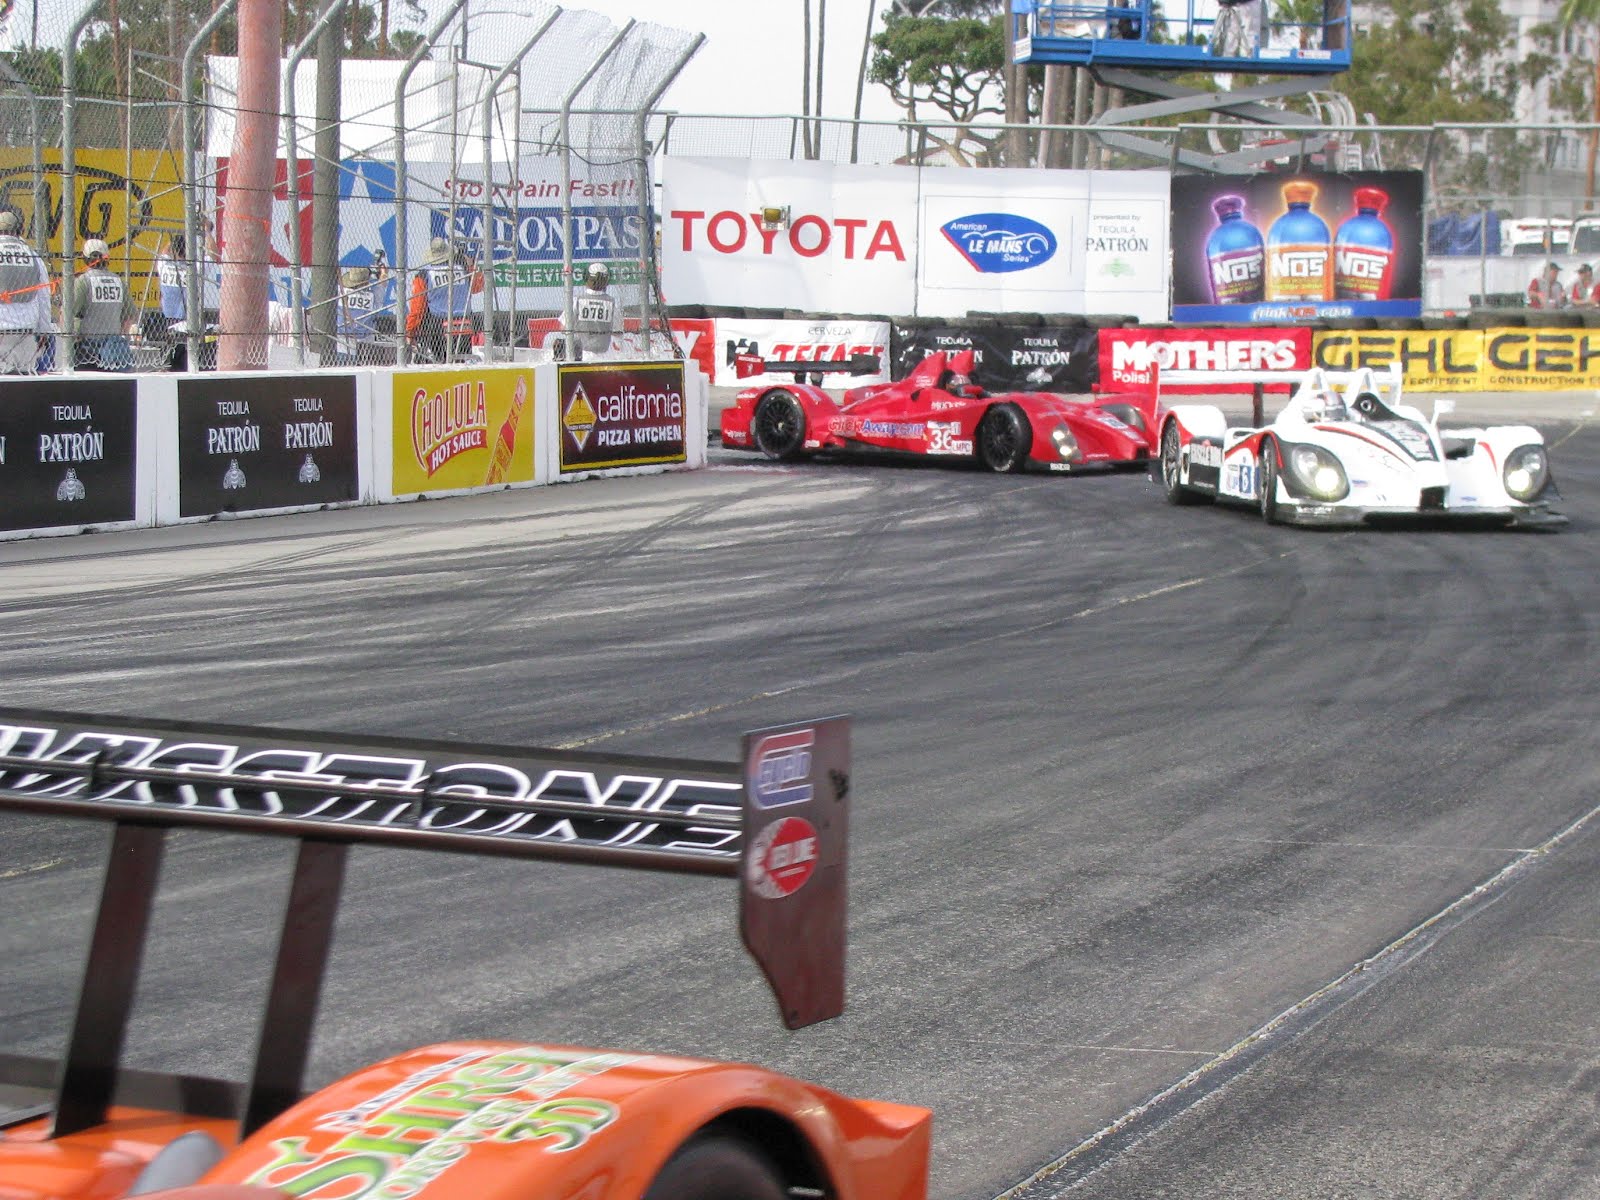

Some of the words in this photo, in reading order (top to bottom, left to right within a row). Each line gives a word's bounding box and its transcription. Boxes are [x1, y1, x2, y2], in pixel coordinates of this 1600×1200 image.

[507, 180, 560, 197] Pain
[950, 223, 988, 231] American
[1098, 225, 1137, 235] TEQUILA
[671, 211, 906, 262] TOYOTA
[968, 240, 983, 253] LE
[986, 240, 1024, 254] MANS
[1003, 253, 1030, 263] Series
[1272, 251, 1328, 277] NOS
[1336, 251, 1389, 280] NOS
[1213, 252, 1263, 285] NOS
[96, 286, 121, 300] 0857
[582, 307, 609, 320] 0781
[808, 326, 852, 336] CERVEZA
[936, 336, 973, 346] TEQUILA
[1023, 338, 1058, 347] TEQUILA
[1112, 339, 1296, 371] MOTHERS
[1315, 336, 1477, 373] GEHL
[1410, 376, 1477, 385] EQUIPMENT
[1490, 375, 1585, 386] CONSTRUCTION
[218, 401, 250, 416] TEQUILA
[294, 398, 323, 412] TEQUILA
[598, 384, 682, 422] california
[53, 405, 92, 421] TEQUILA
[411, 381, 488, 472] CHOLULA
[598, 429, 631, 446] PIZZA
[635, 425, 682, 443] KITCHEN
[431, 439, 451, 471] HOT
[453, 430, 482, 454] SAUCE
